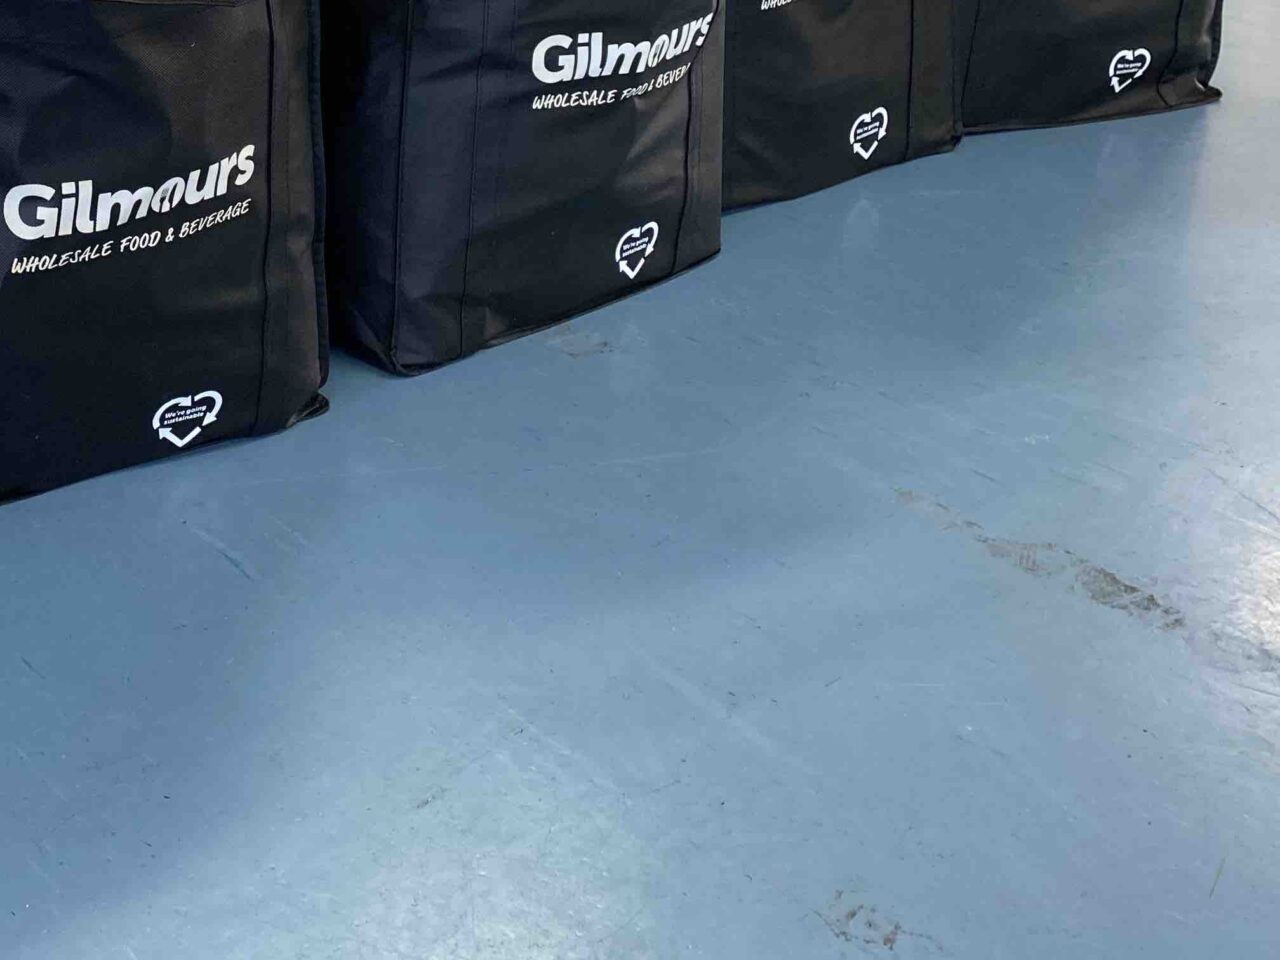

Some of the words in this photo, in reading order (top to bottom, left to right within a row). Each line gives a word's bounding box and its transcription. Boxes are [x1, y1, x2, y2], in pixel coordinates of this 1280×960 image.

[531, 12, 713, 84] Gilmours
[532, 89, 618, 110] WHOLESALE
[3, 144, 255, 240] Gilmours
[11, 240, 114, 275] WHOLESALE
[120, 230, 161, 253] FOOD
[178, 198, 252, 238] BEVERAGE
